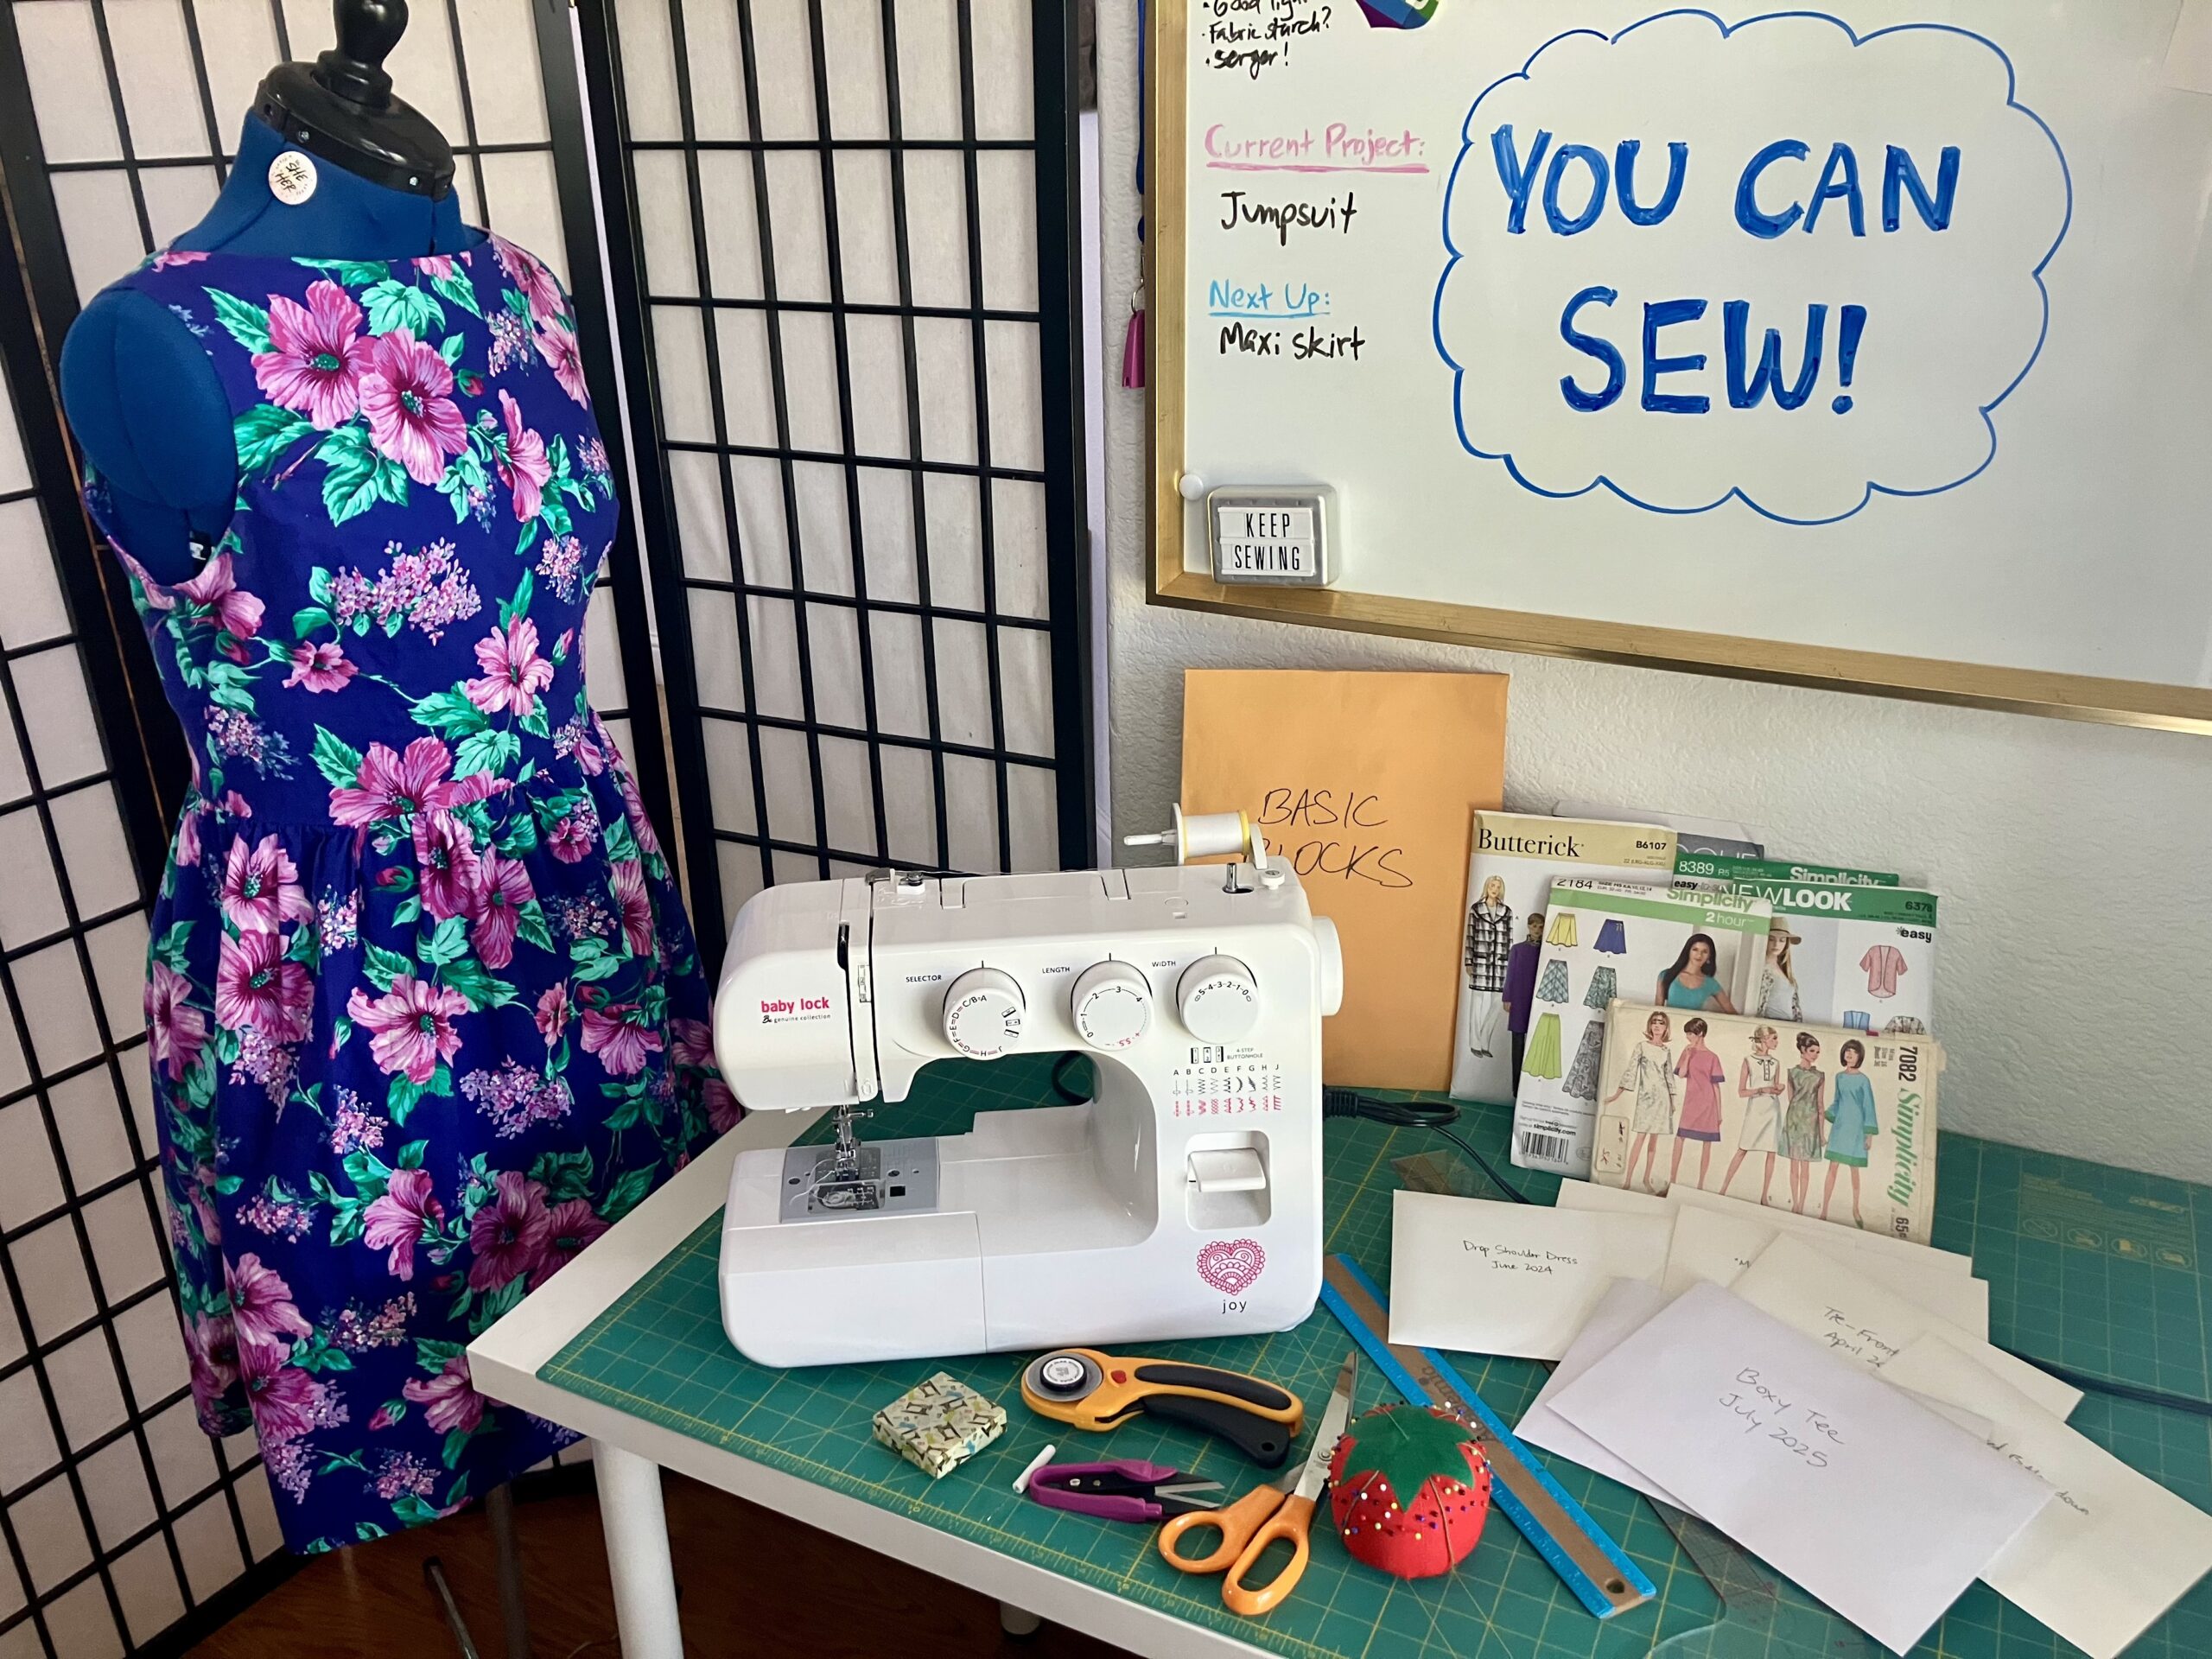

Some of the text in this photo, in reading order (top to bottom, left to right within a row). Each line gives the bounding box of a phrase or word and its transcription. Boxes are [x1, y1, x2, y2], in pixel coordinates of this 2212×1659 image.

[1210, 6, 1332, 43] Fabric starch?
[1205, 123, 1425, 165] Current Project:
[1491, 124, 1961, 238] YOU CAN
[1221, 192, 1357, 246] Jumpsuit
[1210, 279, 1330, 314] Next Up:
[1220, 321, 1280, 355] Maxi
[1560, 286, 1867, 415] SEW!
[1245, 513, 1290, 537] KEEP
[1234, 545, 1300, 570] SEWING
[1258, 788, 1389, 828] BASIC
[1478, 828, 1667, 858] Butterick B6107
[1243, 838, 1413, 887] OCKS
[1679, 861, 1714, 874] 8389
[1557, 878, 1592, 890] 2184
[1667, 887, 1752, 913] Simplicity
[1901, 927, 1932, 944] easy
[761, 996, 830, 1014] baby lock
[1898, 1046, 1918, 1082] 7082
[1887, 1088, 1922, 1207] Simplicity
[1463, 1240, 1578, 1264] Drop Shoulder Dress
[1491, 1261, 1553, 1274] June 2024
[1223, 1300, 1247, 1314] joy
[1736, 1367, 1845, 1445] Boxy Tee
[1719, 1393, 1827, 1467] July 2025
